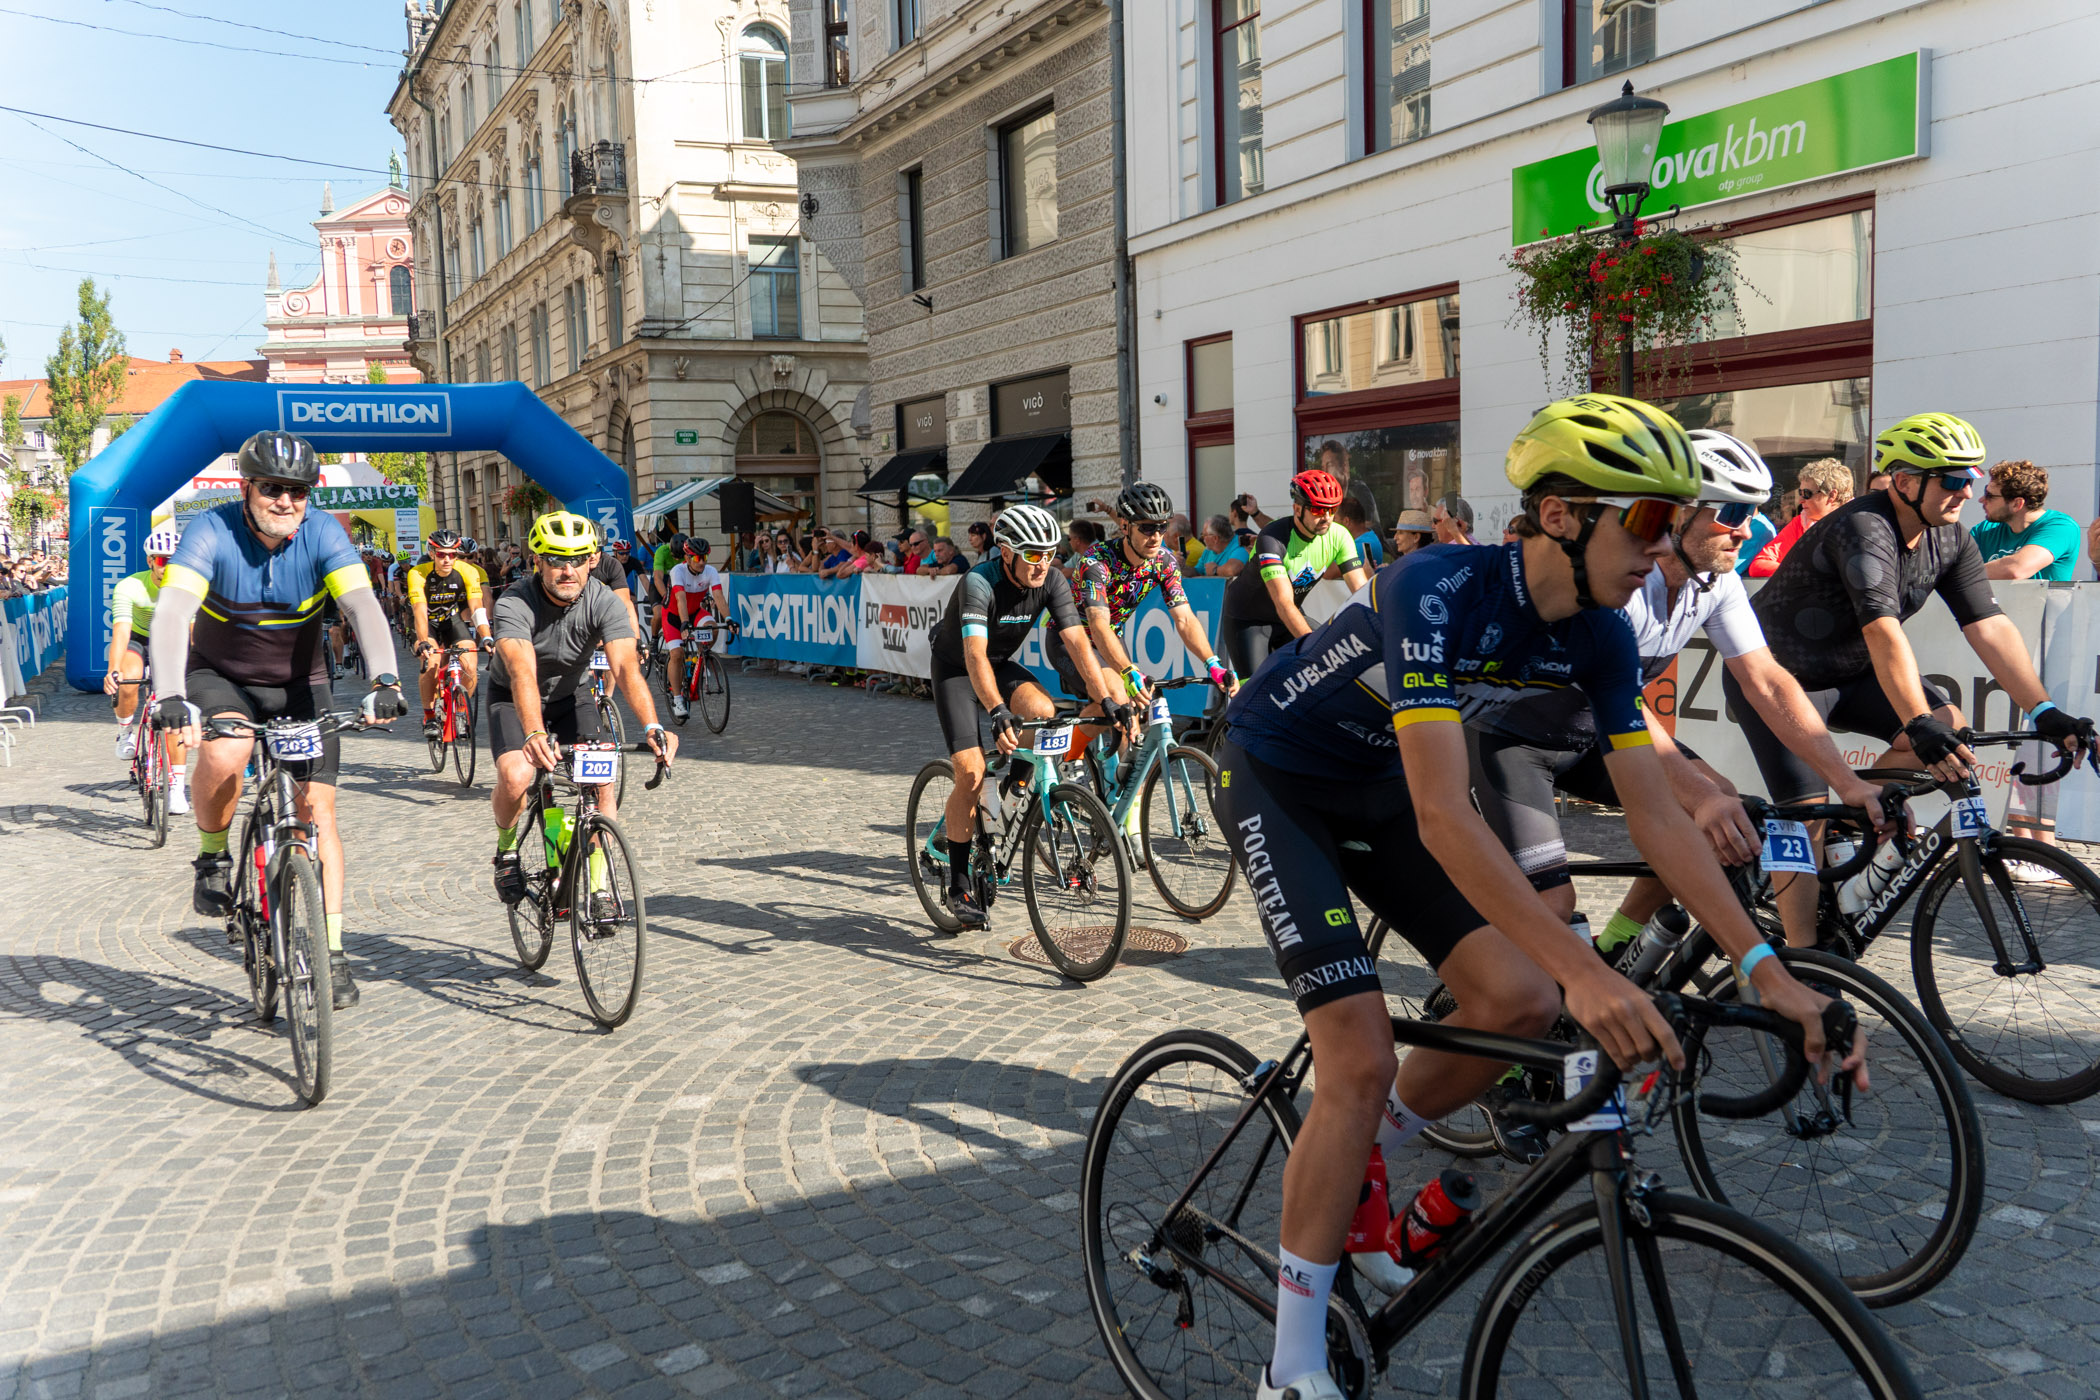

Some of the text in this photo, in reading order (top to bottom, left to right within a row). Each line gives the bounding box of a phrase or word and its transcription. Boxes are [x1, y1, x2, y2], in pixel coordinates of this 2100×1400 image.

[1651, 117, 1806, 189] ovakbm
[1718, 173, 1764, 192] otp group
[1022, 392, 1044, 410] VIGÒ
[291, 402, 440, 424] DECATHLON
[916, 412, 933, 428] VIGÒ
[1701, 451, 1736, 472] RUDY
[313, 485, 418, 507] LJANICA
[1509, 550, 1527, 607] LJUBLJANA
[737, 592, 857, 646] DECATHLON
[596, 657, 610, 665] 18
[1538, 662, 1572, 675] MDM
[1269, 633, 1373, 711] LJUBLJANA
[278, 738, 311, 752] 203
[1044, 736, 1068, 750] 183
[585, 762, 610, 775] 202
[1781, 838, 1804, 859] 23
[1237, 813, 1304, 951] POGI TEAM
[1854, 832, 1941, 937] PINARELLO
[1294, 956, 1377, 998] GENERALI
